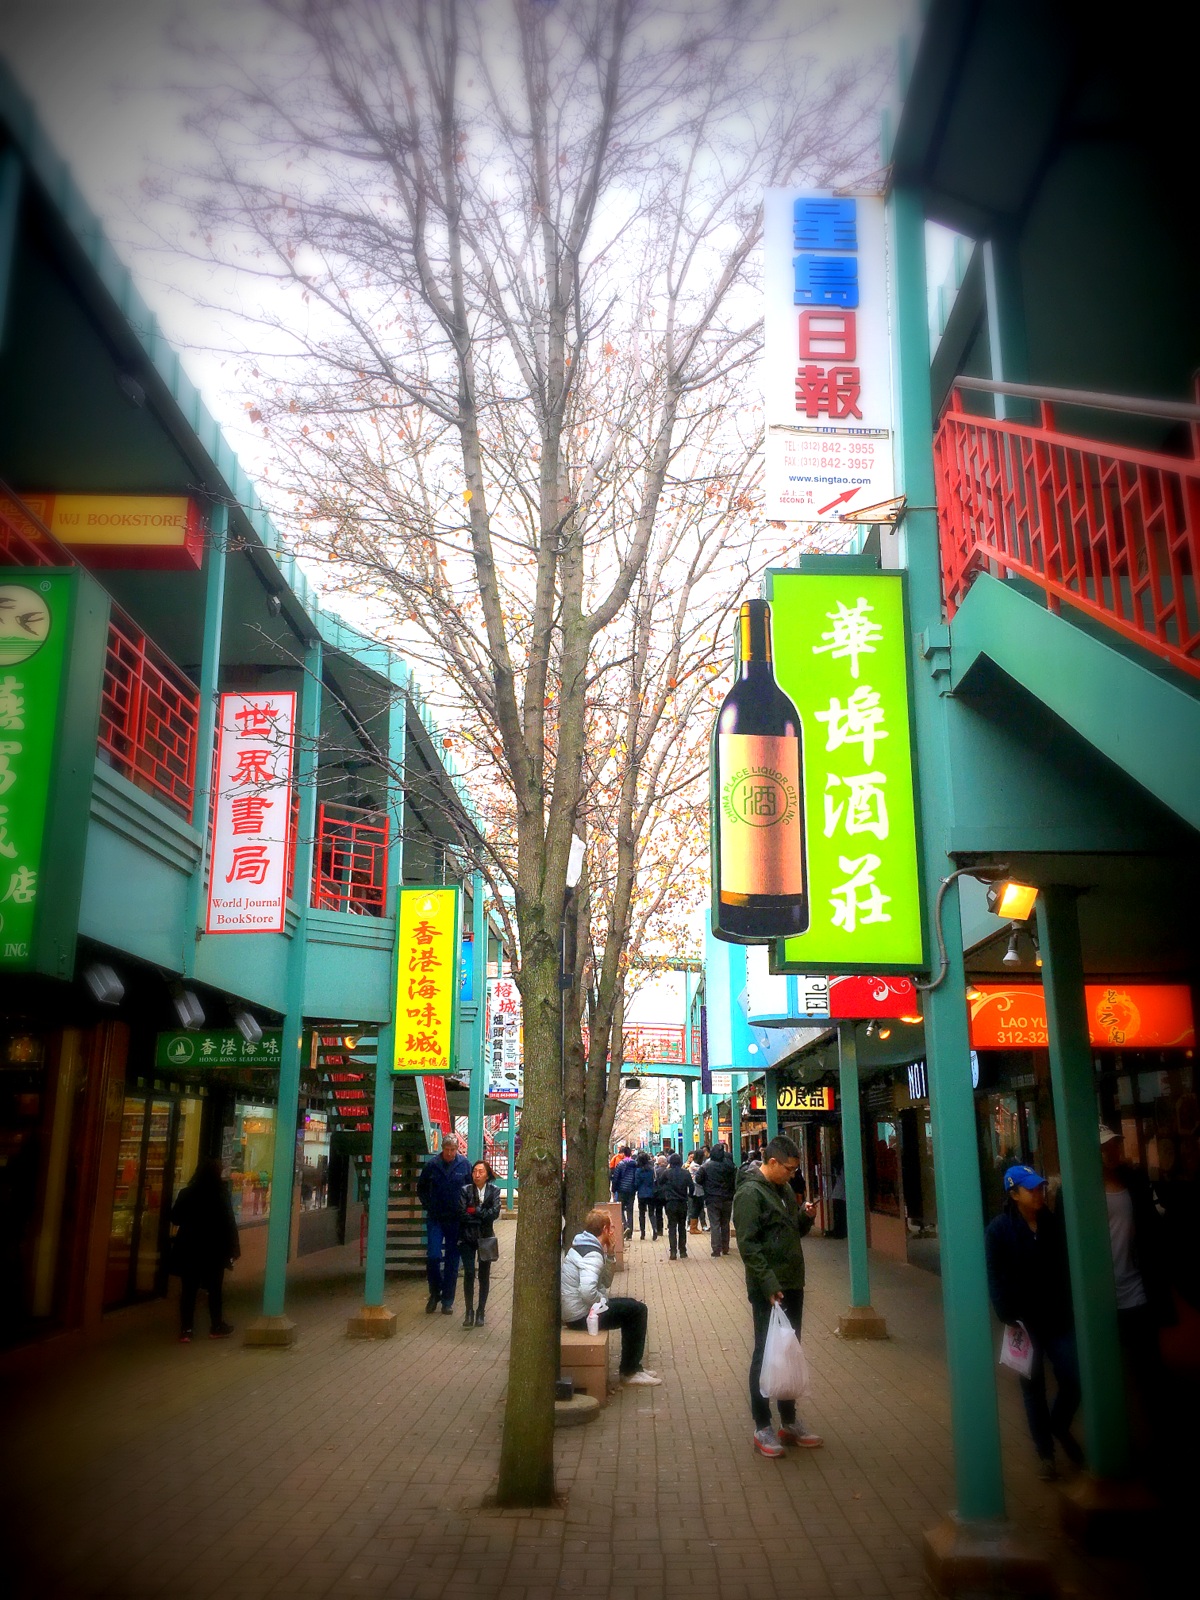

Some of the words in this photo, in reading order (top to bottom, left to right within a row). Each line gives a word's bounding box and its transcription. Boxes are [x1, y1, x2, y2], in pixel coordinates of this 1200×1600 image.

[789, 475, 871, 484] www.singtao.com
[58, 513, 80, 525] WJ
[87, 513, 182, 527] BOOKSTORE
[812, 597, 891, 933] 華埠酒莊
[724, 768, 750, 792] PLACE
[752, 766, 788, 785] LIQUOR
[226, 703, 279, 884] 世界書局
[744, 785, 776, 816] 酒
[722, 795, 738, 824] CHINA
[212, 898, 242, 909] World
[243, 896, 280, 910] Journal
[216, 914, 274, 924] BookStore
[4, 943, 28, 957] INC.
[405, 921, 442, 1056] 香港海味城
[805, 983, 828, 1010] Elle
[1001, 1017, 1028, 1028] LAO
[1030, 1017, 1048, 1028] YU
[201, 1038, 279, 1056] 香港海味
[761, 1088, 825, 1108] の良品
